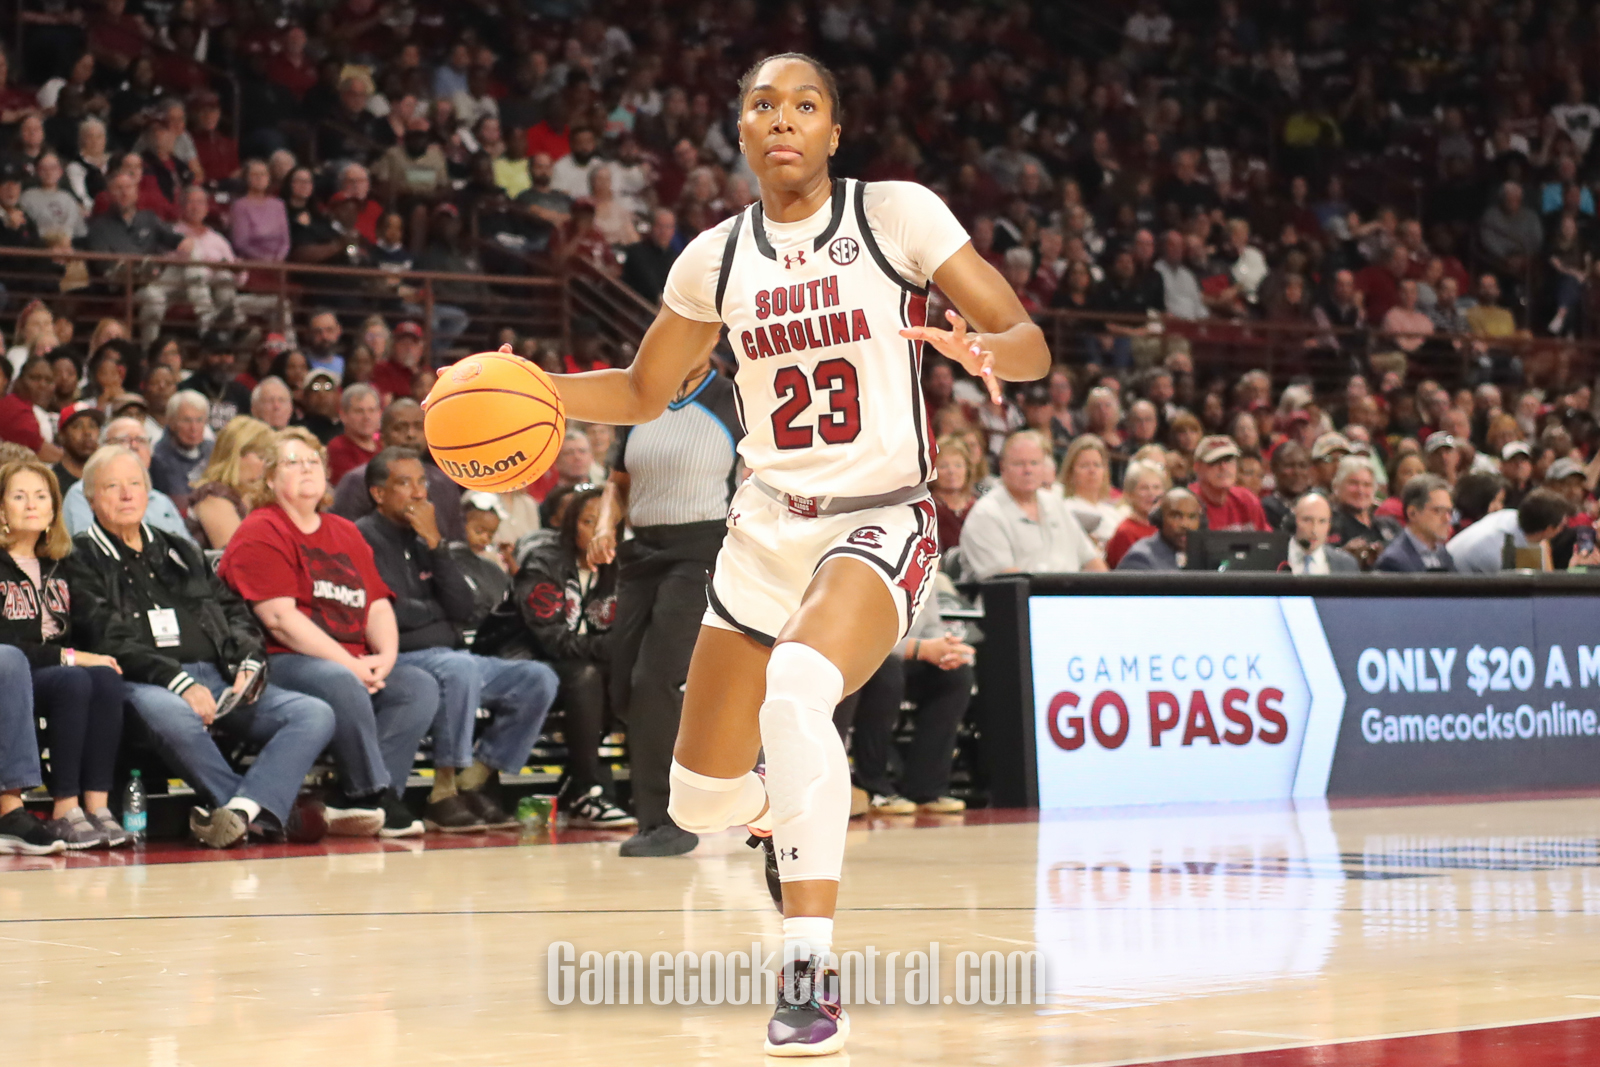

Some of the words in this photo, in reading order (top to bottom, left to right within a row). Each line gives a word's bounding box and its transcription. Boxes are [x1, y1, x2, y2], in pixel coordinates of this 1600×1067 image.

[830, 238, 858, 264] SEC
[755, 275, 840, 320] SOUTH
[741, 308, 871, 360] CAROLINA
[771, 357, 862, 450] 23
[441, 451, 528, 478] Wilson
[1068, 654, 1263, 683] GAMECOCK
[1357, 647, 1456, 694] ONLY
[1466, 645, 1535, 697] $20
[1544, 644, 1572, 689] A
[1577, 644, 1600, 689] M
[1047, 690, 1130, 751] GO
[1148, 687, 1288, 747] PASS
